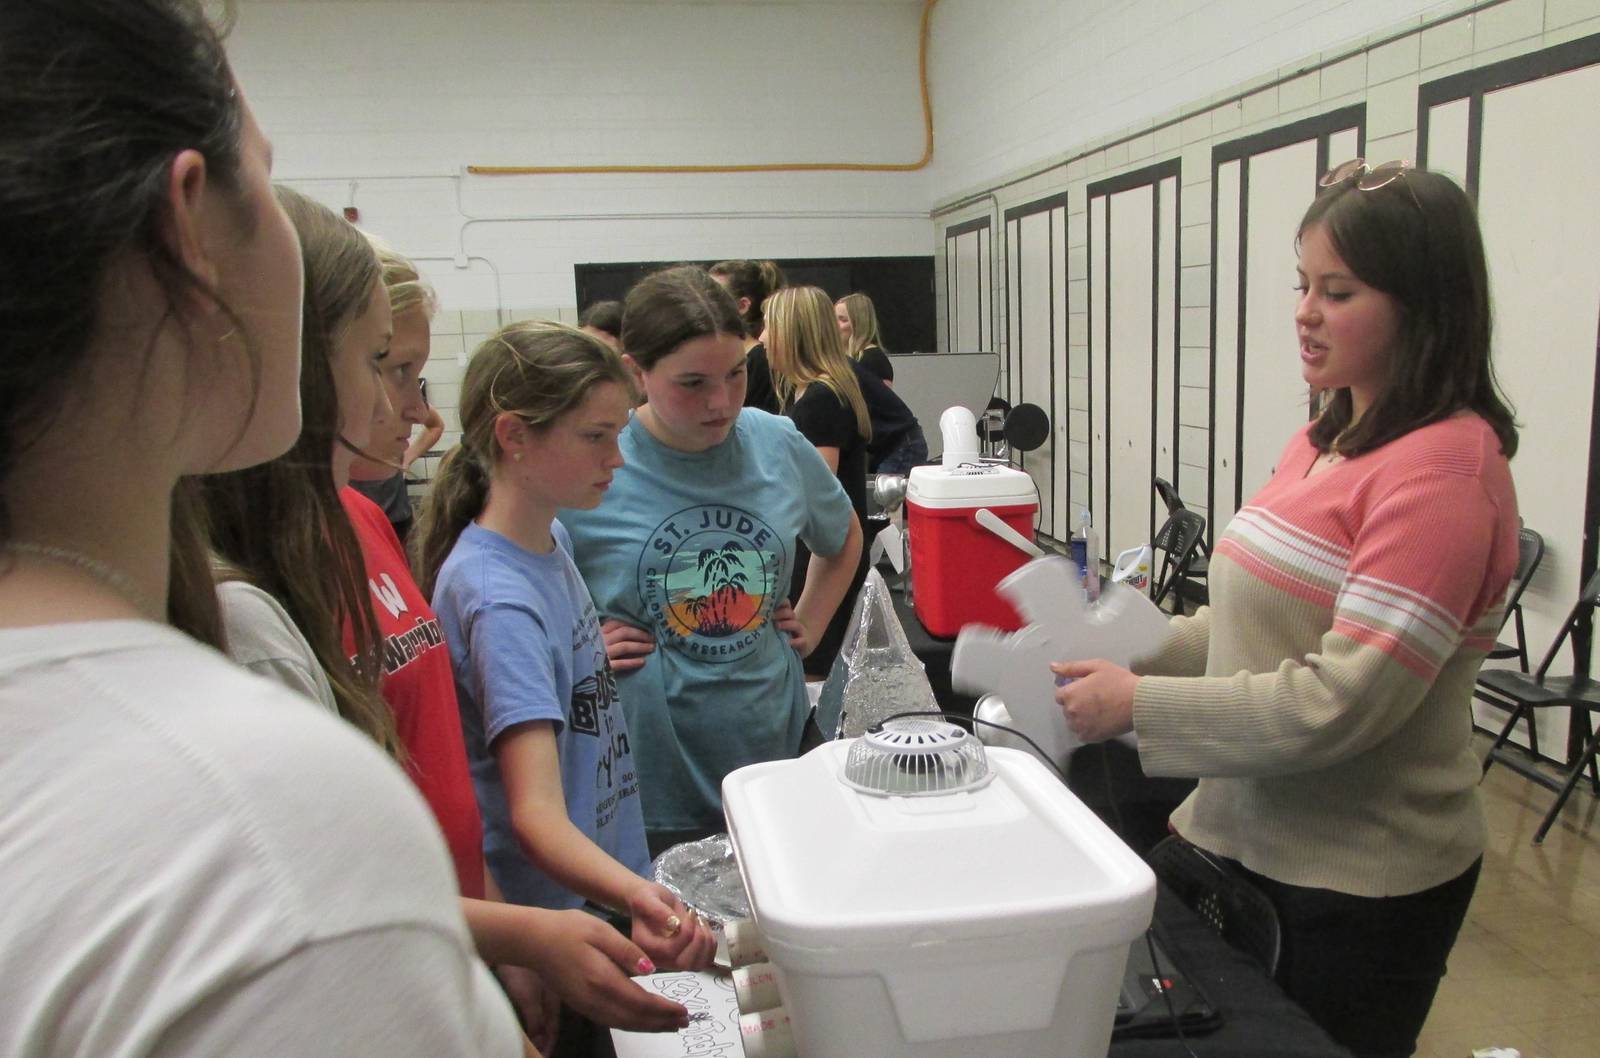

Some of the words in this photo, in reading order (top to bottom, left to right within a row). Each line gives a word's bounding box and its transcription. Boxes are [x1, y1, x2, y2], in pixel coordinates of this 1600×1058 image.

[654, 522, 690, 555] ST.
[700, 510, 771, 548] JUDE
[690, 631, 761, 655] RESEARCH
